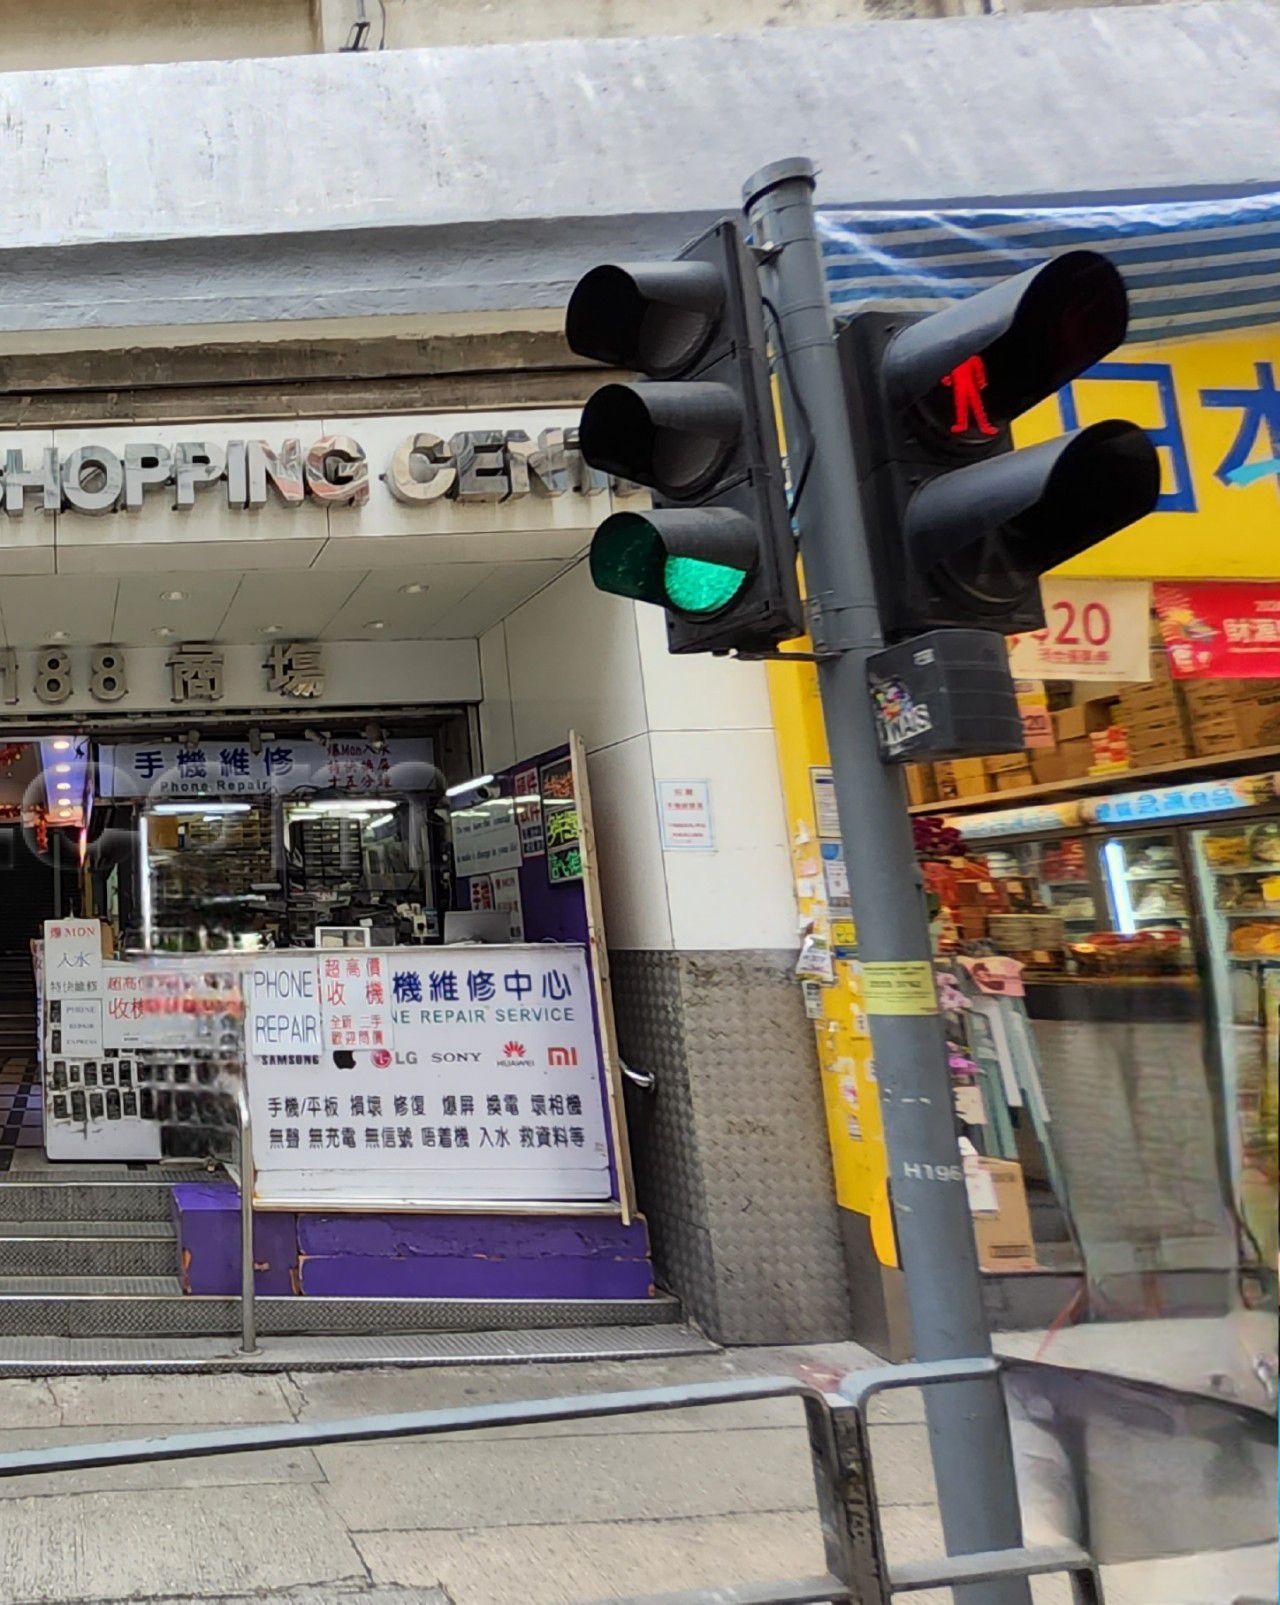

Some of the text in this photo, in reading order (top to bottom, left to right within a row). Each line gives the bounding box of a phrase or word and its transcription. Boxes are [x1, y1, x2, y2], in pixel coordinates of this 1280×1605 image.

[380, 426, 651, 505] CENT
[135, 745, 293, 779] 手機維修
[160, 778, 269, 793] Phone Repair
[253, 970, 314, 999] PHONE
[392, 969, 573, 1003] 機維修中心
[255, 1014, 318, 1044] REPAIR
[420, 1008, 486, 1023] REPAIR
[495, 1007, 575, 1023] SERVICE
[261, 1055, 320, 1065] SAMSUNG
[431, 1051, 482, 1064] SONY
